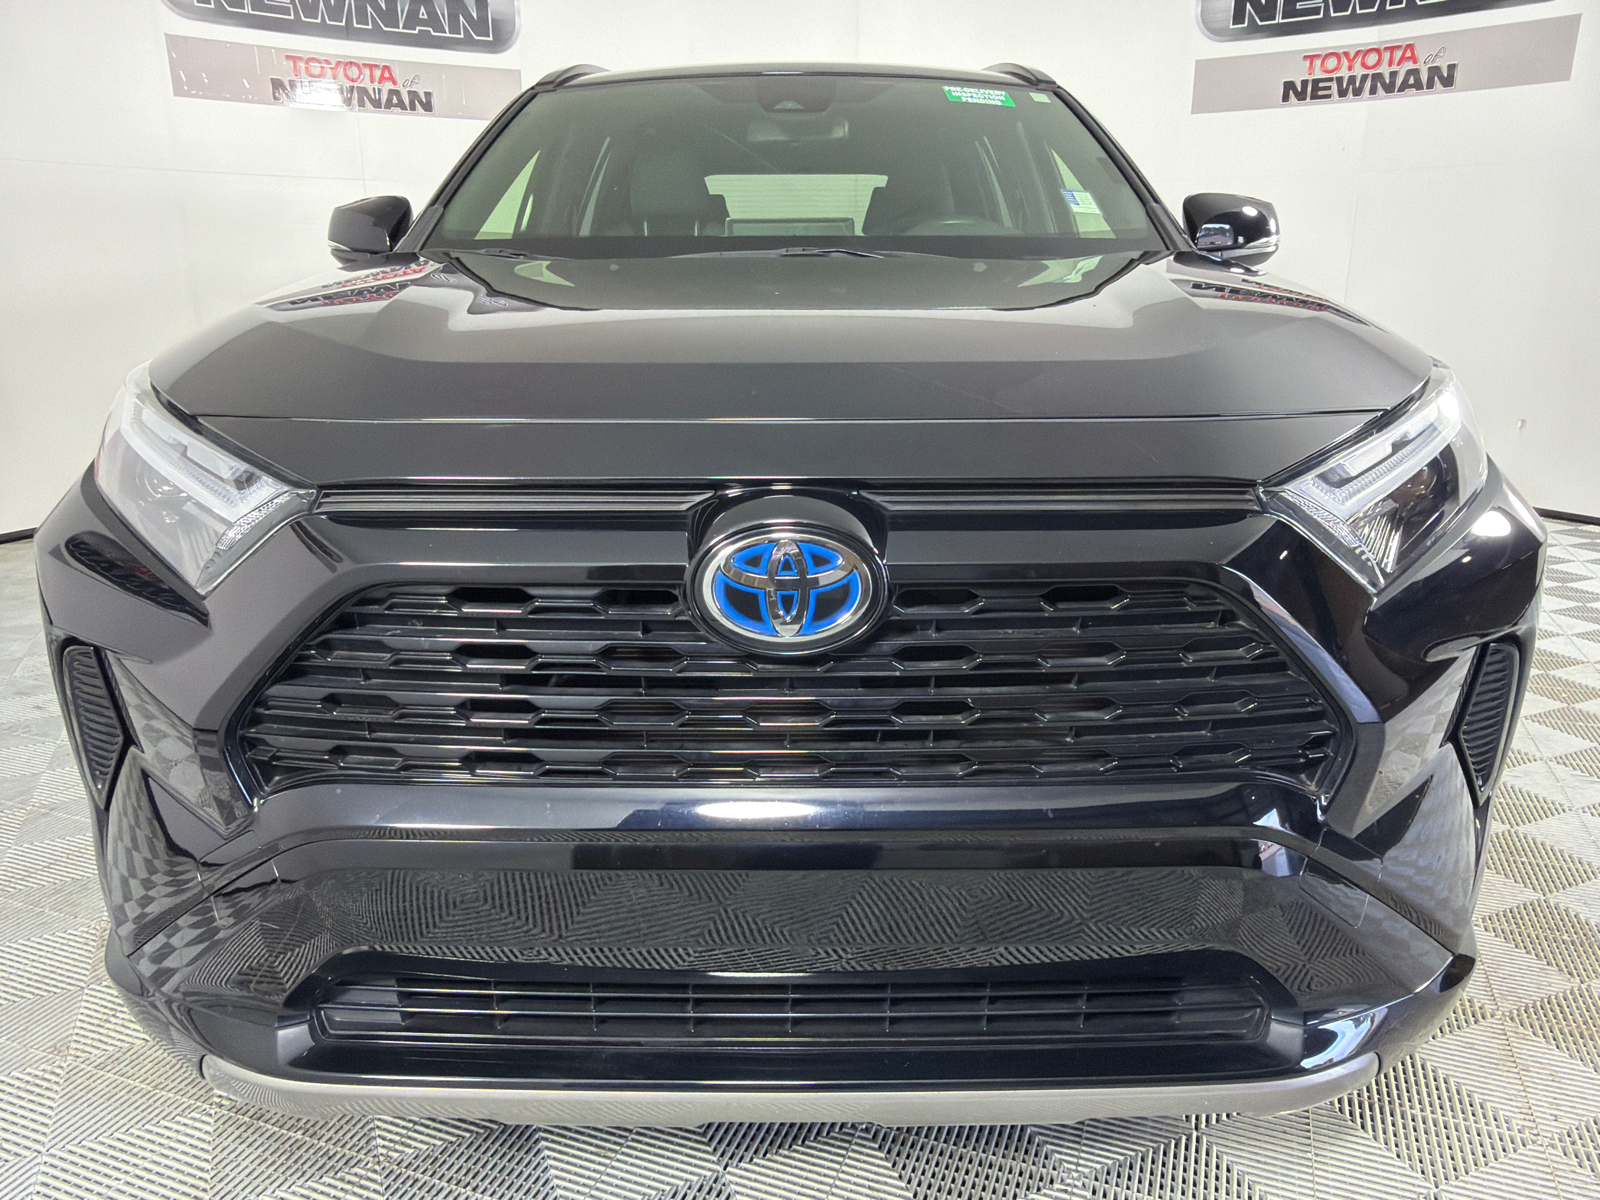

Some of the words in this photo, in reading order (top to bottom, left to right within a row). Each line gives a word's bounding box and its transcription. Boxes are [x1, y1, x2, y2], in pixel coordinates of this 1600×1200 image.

[194, 0, 493, 40] WNAN
[285, 55, 398, 86] TOYOTA
[402, 74, 419, 88] of
[1302, 43, 1418, 76] TOYOTA
[1423, 46, 1446, 65] of
[270, 78, 434, 112] NNAN
[952, 92, 1006, 101] INSPECTION
[1281, 63, 1457, 103] NEWNAN
[961, 97, 1002, 105] PENDING
